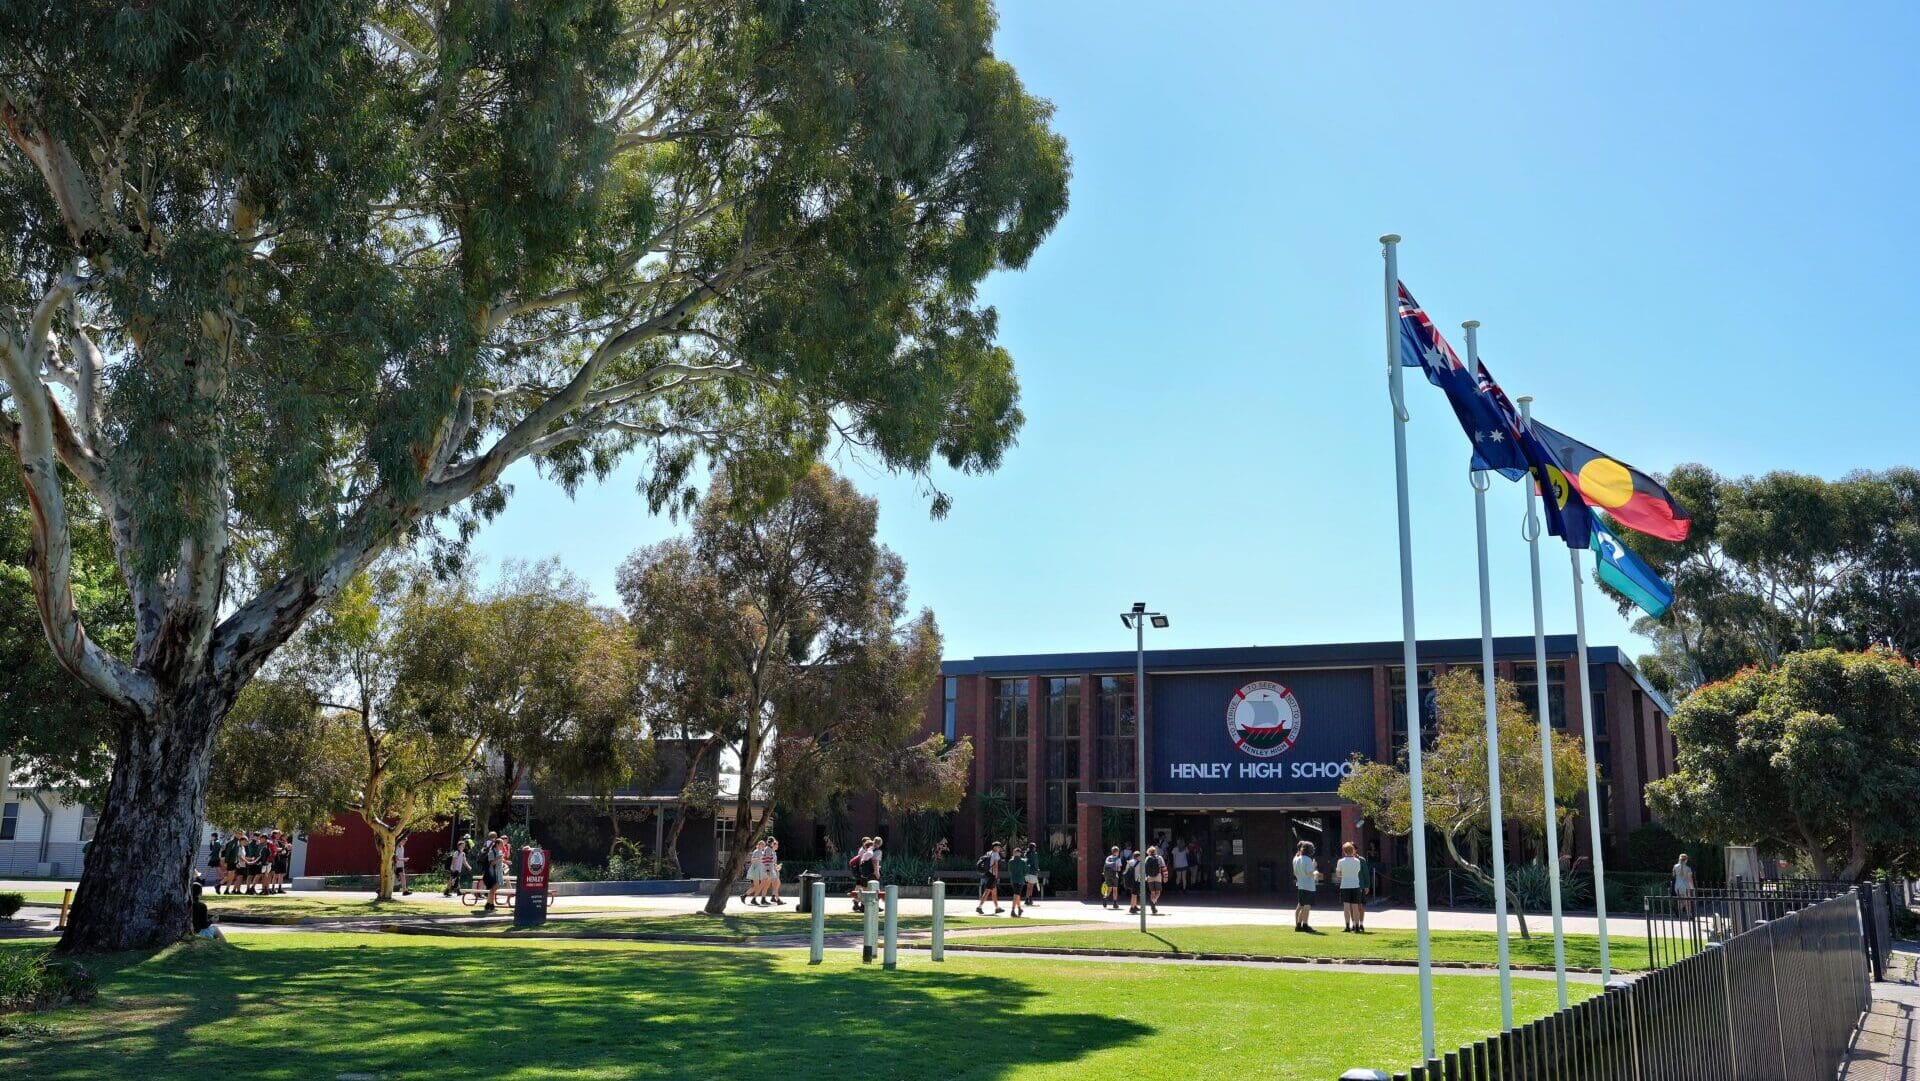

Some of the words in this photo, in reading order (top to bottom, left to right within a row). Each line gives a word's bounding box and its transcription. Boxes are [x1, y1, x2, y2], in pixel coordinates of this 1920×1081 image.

[1287, 694, 1298, 709] NOT
[1242, 744, 1268, 755] HENLEY
[1270, 743, 1287, 754] HIGH
[1170, 763, 1232, 779] HENLEY
[1239, 762, 1282, 778] HIGH
[1291, 761, 1355, 778] SCHOO
